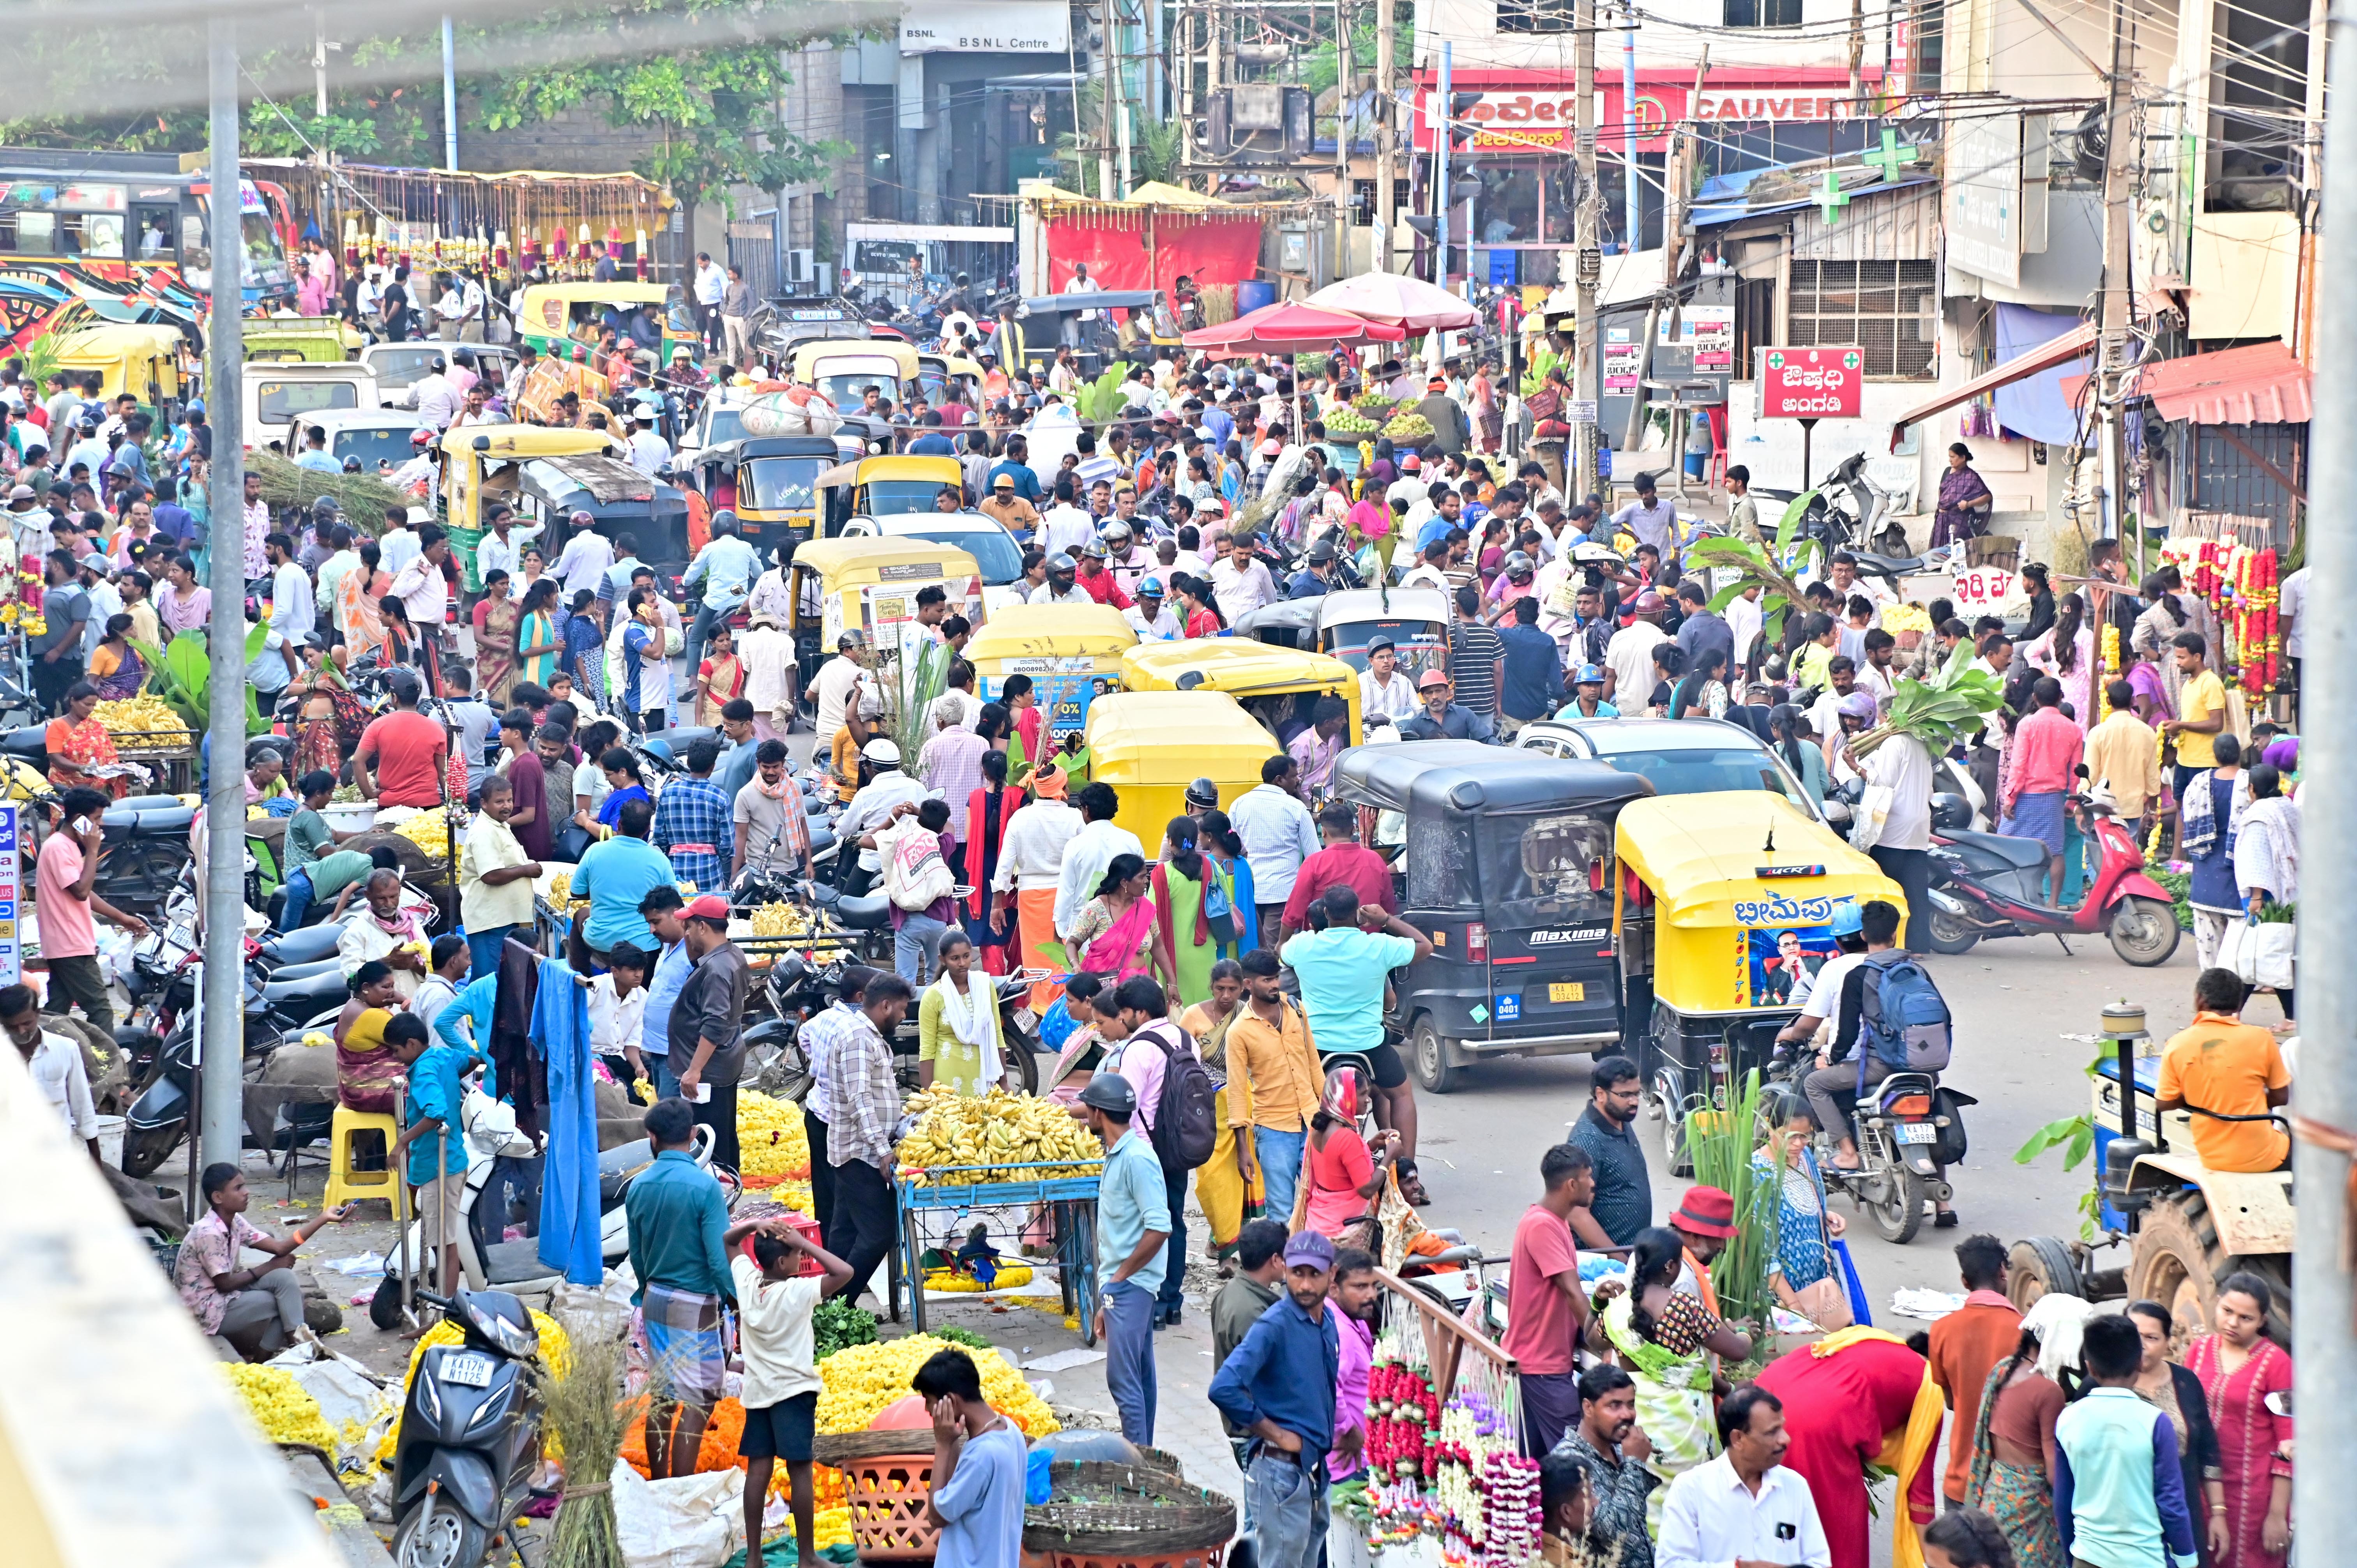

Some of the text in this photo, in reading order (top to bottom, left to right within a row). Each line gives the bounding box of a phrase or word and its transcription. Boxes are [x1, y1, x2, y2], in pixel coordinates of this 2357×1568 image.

[1010, 41, 1049, 50] Centre
[1722, 323, 1730, 332] 16
[1632, 346, 1639, 355] 16
[1782, 365, 1844, 391] ಔಷಧಿ
[1782, 393, 1841, 412] ಅಂಗಡಿ
[781, 483, 800, 498] LOVE
[799, 486, 810, 497] MY
[1956, 574, 1987, 605] ಇಡ್ಲಿ
[1765, 866, 1809, 875] LUCKY
[1530, 929, 1607, 942] Maxima
[1498, 1005, 1518, 1014] 0401
[1920, 1125, 1929, 1133] 17
[451, 1358, 485, 1373] KA17H
[449, 1368, 482, 1383] N1125
